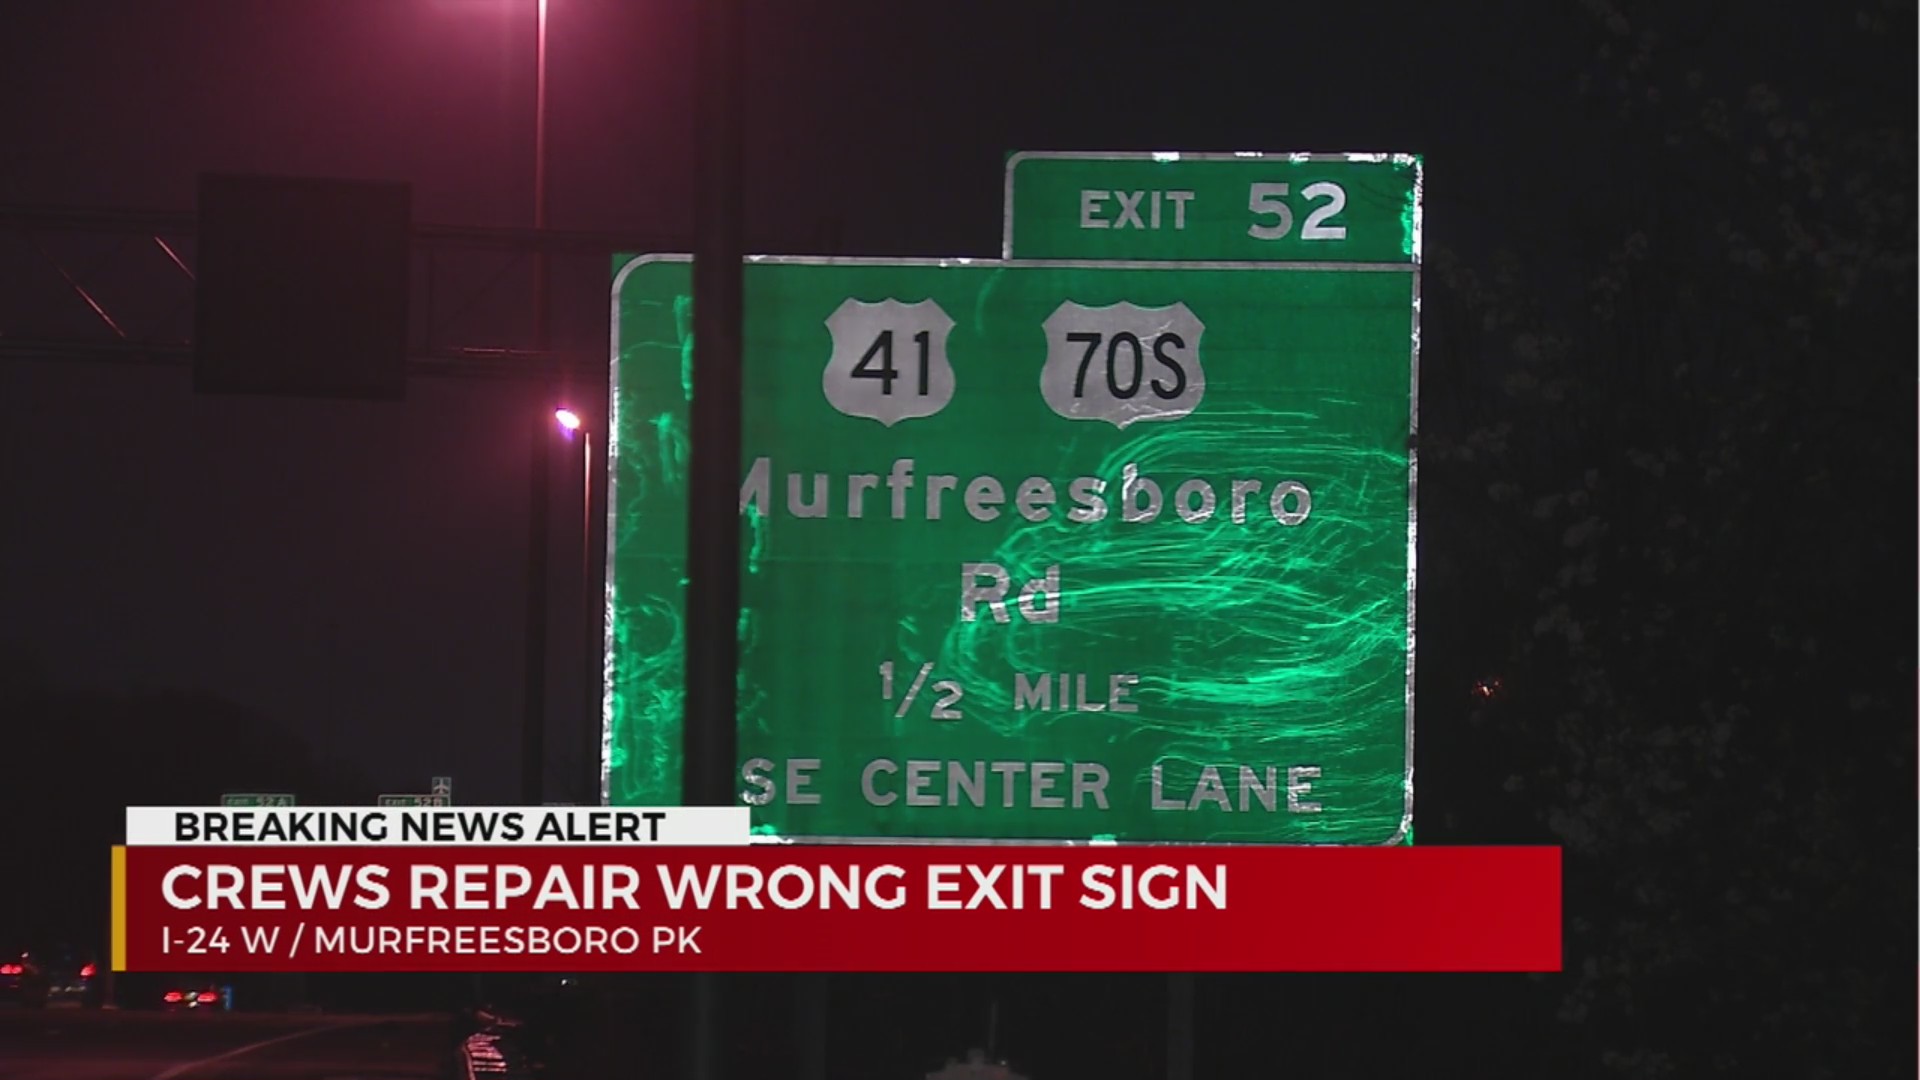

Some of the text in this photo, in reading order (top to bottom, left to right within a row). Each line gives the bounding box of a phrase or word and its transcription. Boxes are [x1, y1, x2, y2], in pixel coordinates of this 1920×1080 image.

[1080, 182, 1347, 241] EXIT 52
[850, 329, 930, 396] 41
[1066, 331, 1187, 400] 70S
[961, 563, 1061, 625] Rd
[879, 661, 1140, 720] 1/2 MILE
[738, 758, 1322, 814] SE CENTER LANE
